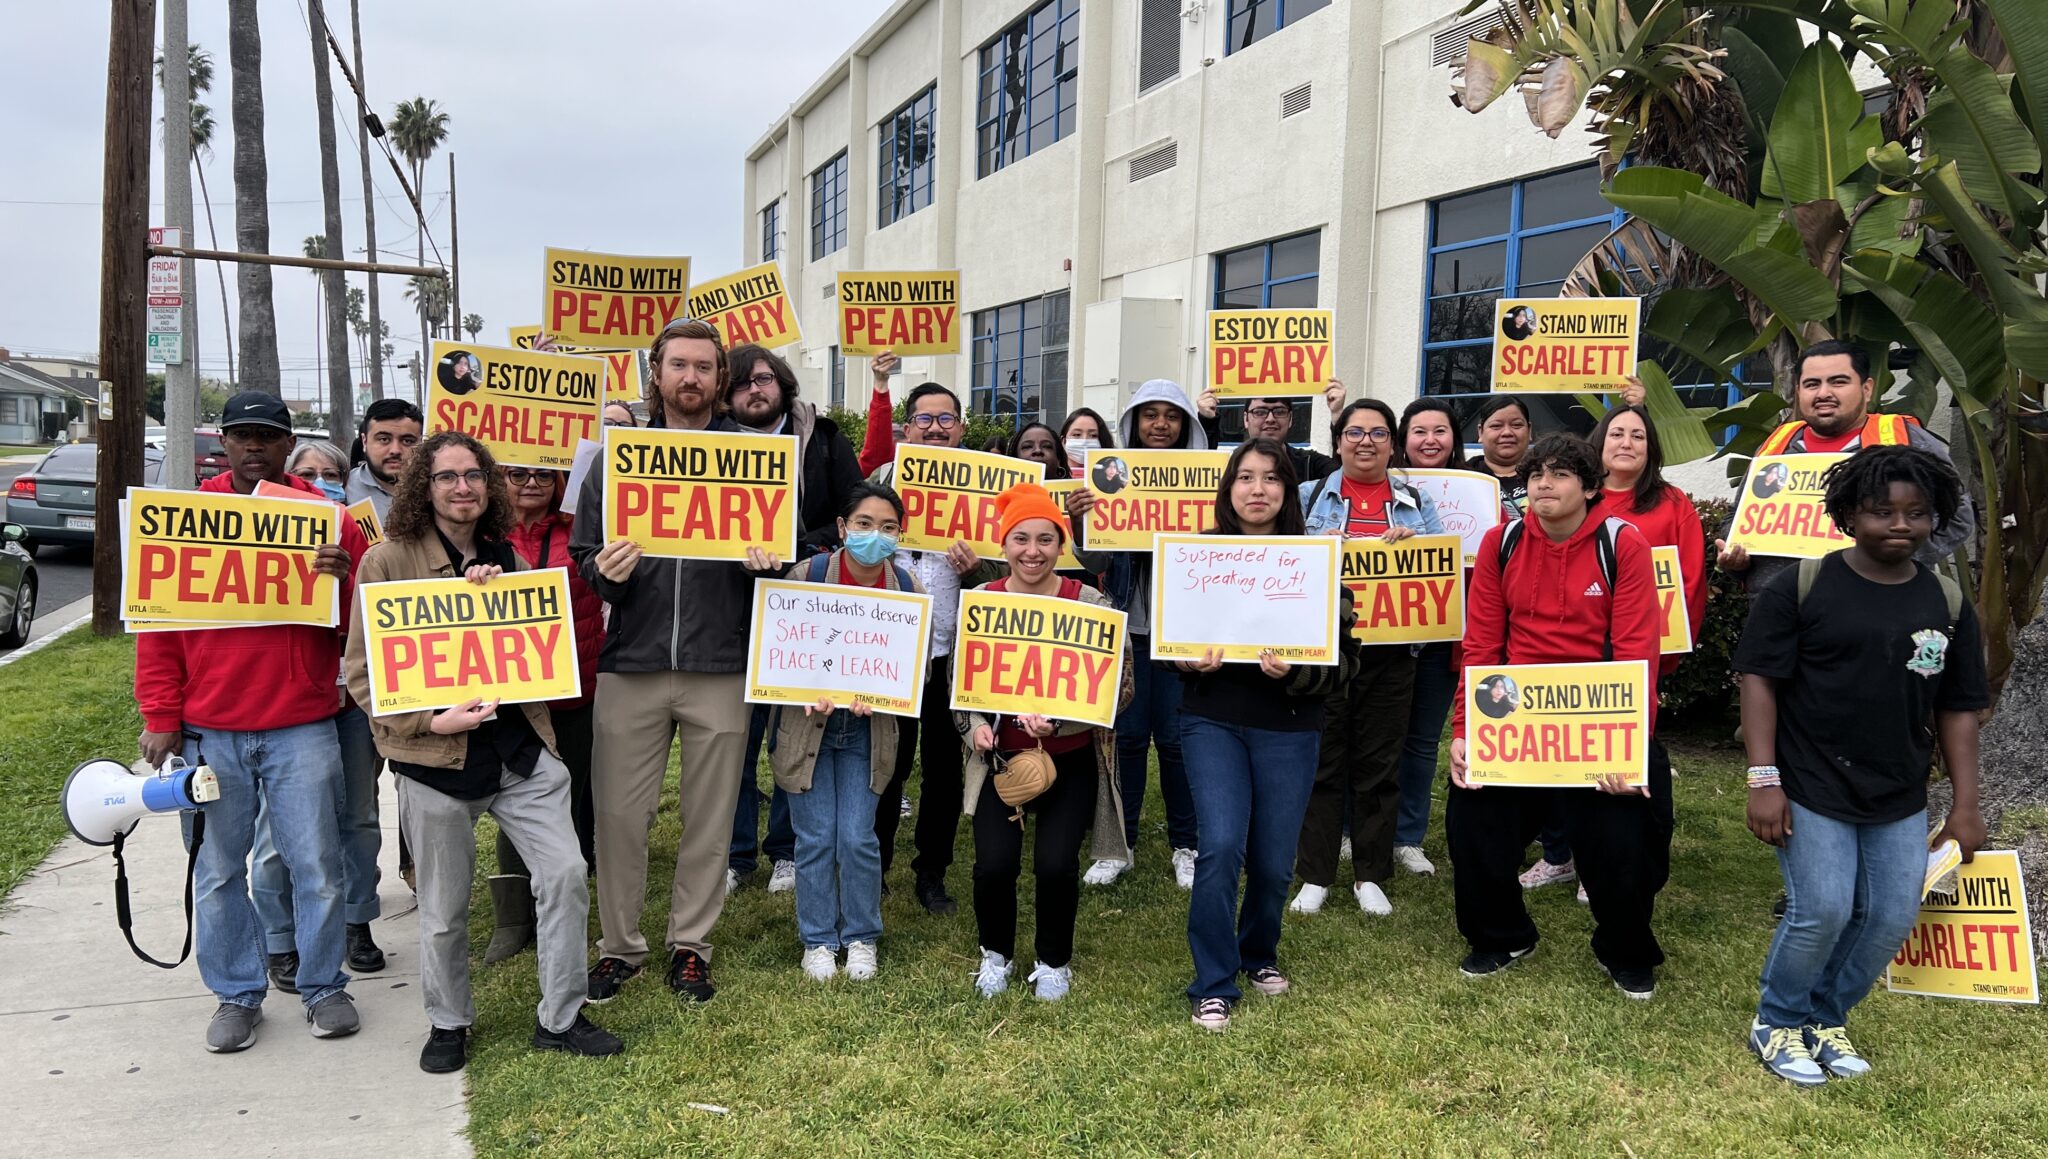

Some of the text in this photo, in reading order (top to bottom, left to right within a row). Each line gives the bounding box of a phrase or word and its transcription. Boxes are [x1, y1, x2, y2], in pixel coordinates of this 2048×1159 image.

[150, 231, 161, 244] NO
[151, 262, 178, 270] FRIDAY
[552, 260, 682, 290] STAND WITH
[688, 272, 779, 319] TAND WITH
[843, 280, 955, 302] STAND WITH
[552, 290, 682, 336] PEARY
[707, 296, 786, 350] ARY
[845, 306, 955, 345] PEARY
[1540, 314, 1628, 334] STAND WITH
[151, 336, 157, 346] 2
[1215, 316, 1327, 341] ESTOY CON
[1215, 345, 1328, 385] PEARY
[1501, 344, 1629, 375] SCARLETT
[486, 362, 552, 394] ESTOY
[556, 370, 597, 399] CON
[435, 398, 596, 448] SCARLETT
[540, 456, 559, 464] STAND
[616, 443, 786, 480] STAND WITH
[901, 457, 972, 487] STAND
[1131, 466, 1221, 487] STAND WITH
[1788, 470, 1825, 491] STA
[139, 504, 328, 545] STAND WITH
[616, 482, 787, 542] PEARY
[901, 488, 1001, 544] PEAR
[1175, 546, 1299, 568] Suspended for
[1341, 547, 1454, 576] AND WITH
[138, 544, 321, 606] PEARY
[1184, 569, 1256, 594] Speaking
[128, 605, 147, 613] UTLA
[376, 585, 558, 629] STAND WITH
[768, 593, 919, 626] Our students deserve
[1353, 579, 1456, 629] EARY
[776, 618, 890, 647] SAFE and CLEAN
[967, 604, 1116, 649] STAND WITH
[381, 624, 562, 693] PEARY
[769, 648, 820, 671] PLACE
[822, 658, 833, 672] to
[1158, 645, 1173, 653] UTLA
[1286, 648, 1304, 657] WITH
[1304, 648, 1326, 657] PEARY
[964, 640, 1113, 705] PEARY
[379, 697, 398, 707] UTLA
[752, 689, 768, 697] UTLA
[854, 694, 911, 709] STAND WITH PEARY
[957, 695, 970, 703] UTLA
[1523, 682, 1634, 710] STAND WITH
[1477, 722, 1638, 763] SCARLETT
[1472, 770, 1487, 778] UTLA
[1962, 877, 2012, 907] WITH
[1973, 983, 2029, 995] STAND WITH PEARY
